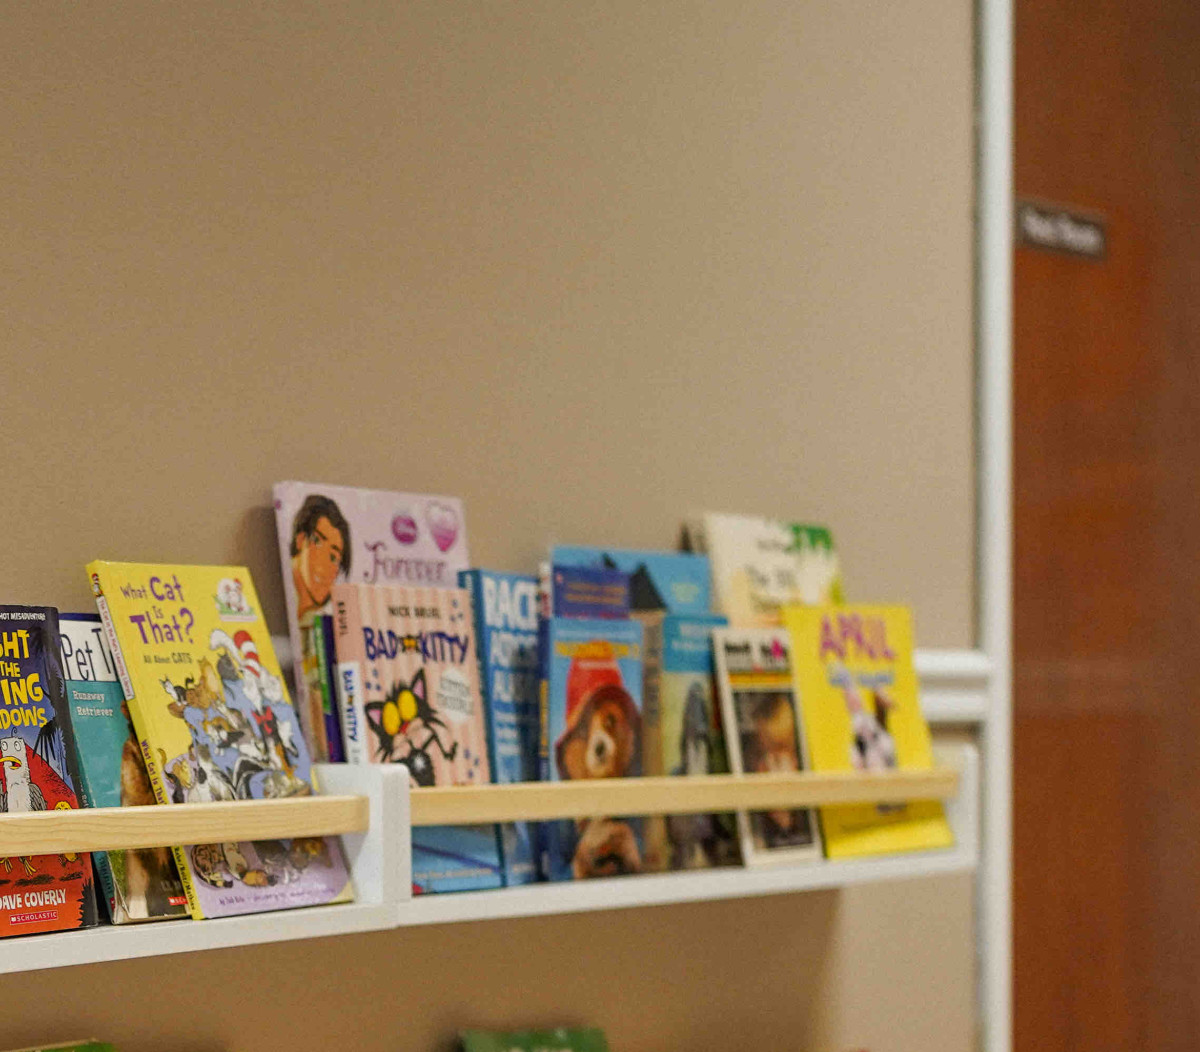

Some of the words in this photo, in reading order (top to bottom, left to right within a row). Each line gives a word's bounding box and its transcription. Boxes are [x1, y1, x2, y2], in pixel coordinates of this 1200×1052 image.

[363, 540, 448, 583] Forever
[120, 582, 147, 600] What
[150, 575, 184, 602] Cat
[11, 611, 46, 622] MISADVENTURE
[152, 605, 163, 620] Is
[388, 606, 410, 618] NICK
[129, 606, 194, 645] That?
[362, 626, 399, 660] BAD
[417, 631, 469, 664] KITTY
[61, 633, 94, 682] Pet
[73, 690, 105, 703] Runaway
[121, 676, 132, 698] Library
[77, 706, 114, 717] Retriever
[24, 888, 66, 908] COVERLY
[15, 911, 58, 923] SCHOLASTIC
